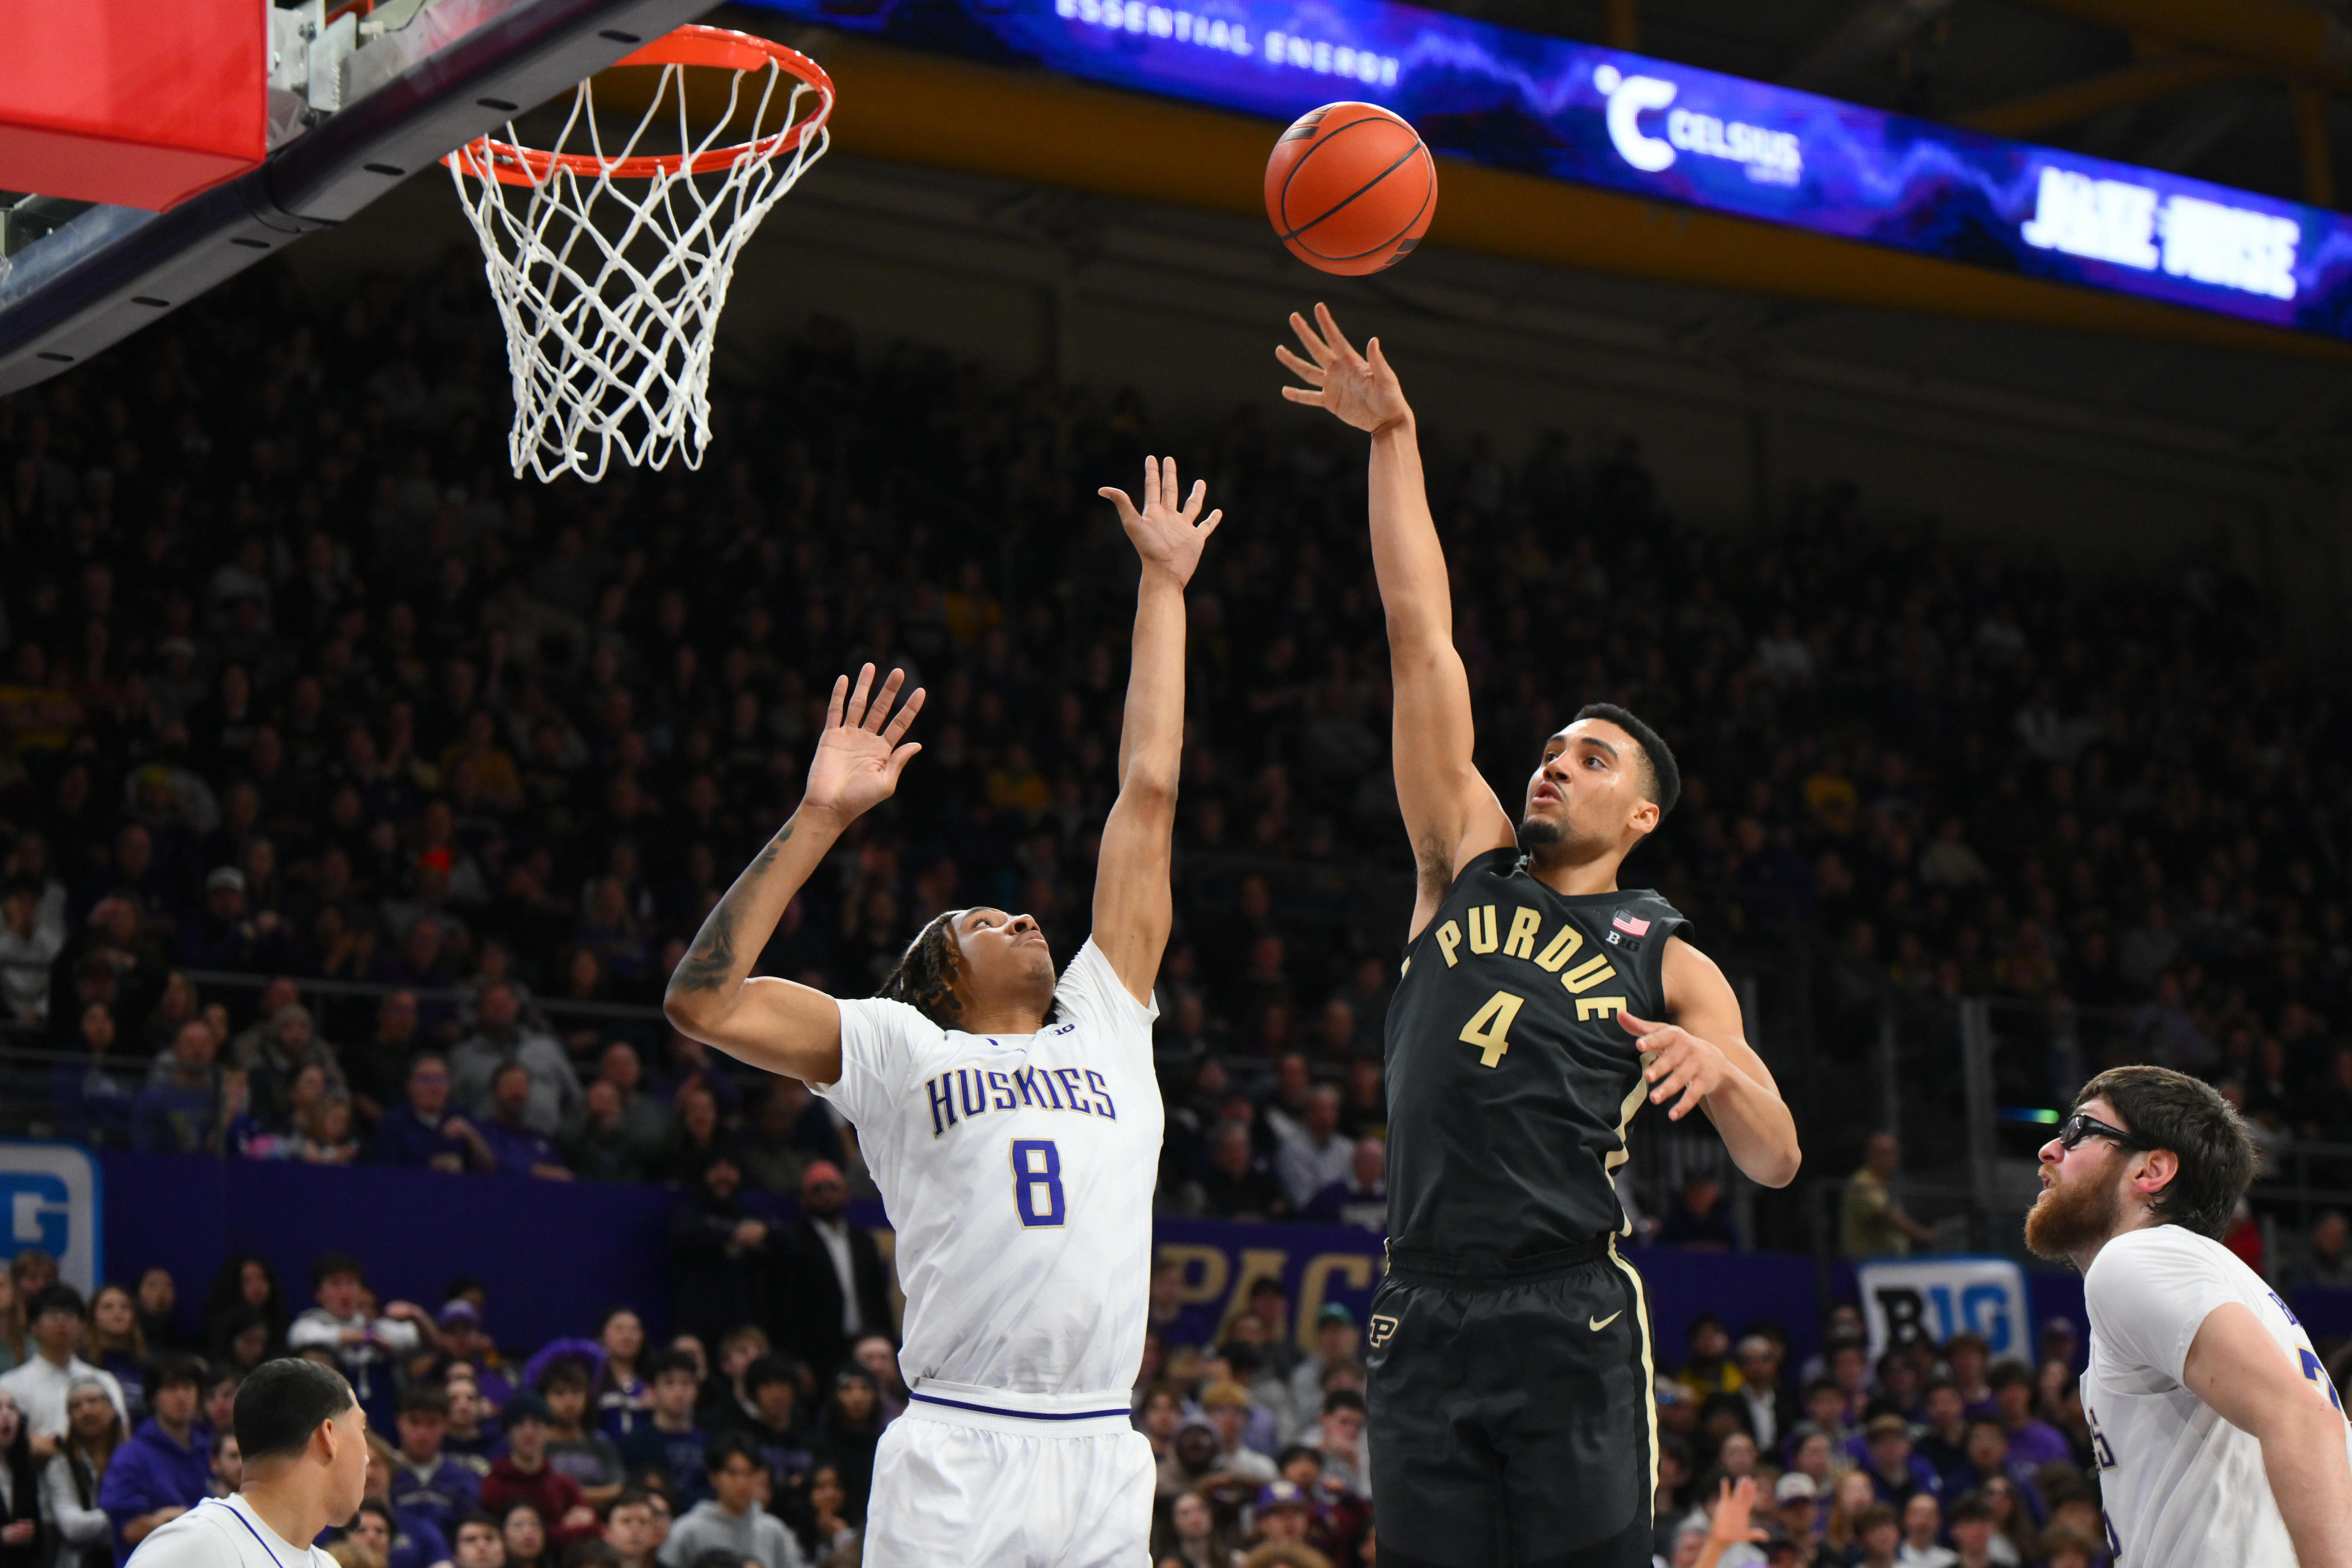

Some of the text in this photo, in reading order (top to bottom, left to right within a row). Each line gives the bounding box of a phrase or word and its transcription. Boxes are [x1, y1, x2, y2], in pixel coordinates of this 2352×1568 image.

[1435, 904, 1627, 1022] PURDUE
[1458, 990, 1525, 1069] 4
[925, 1063, 1117, 1140] HUSKIES
[1009, 1137, 1068, 1230] 8
[1369, 1314, 1399, 1348] P
